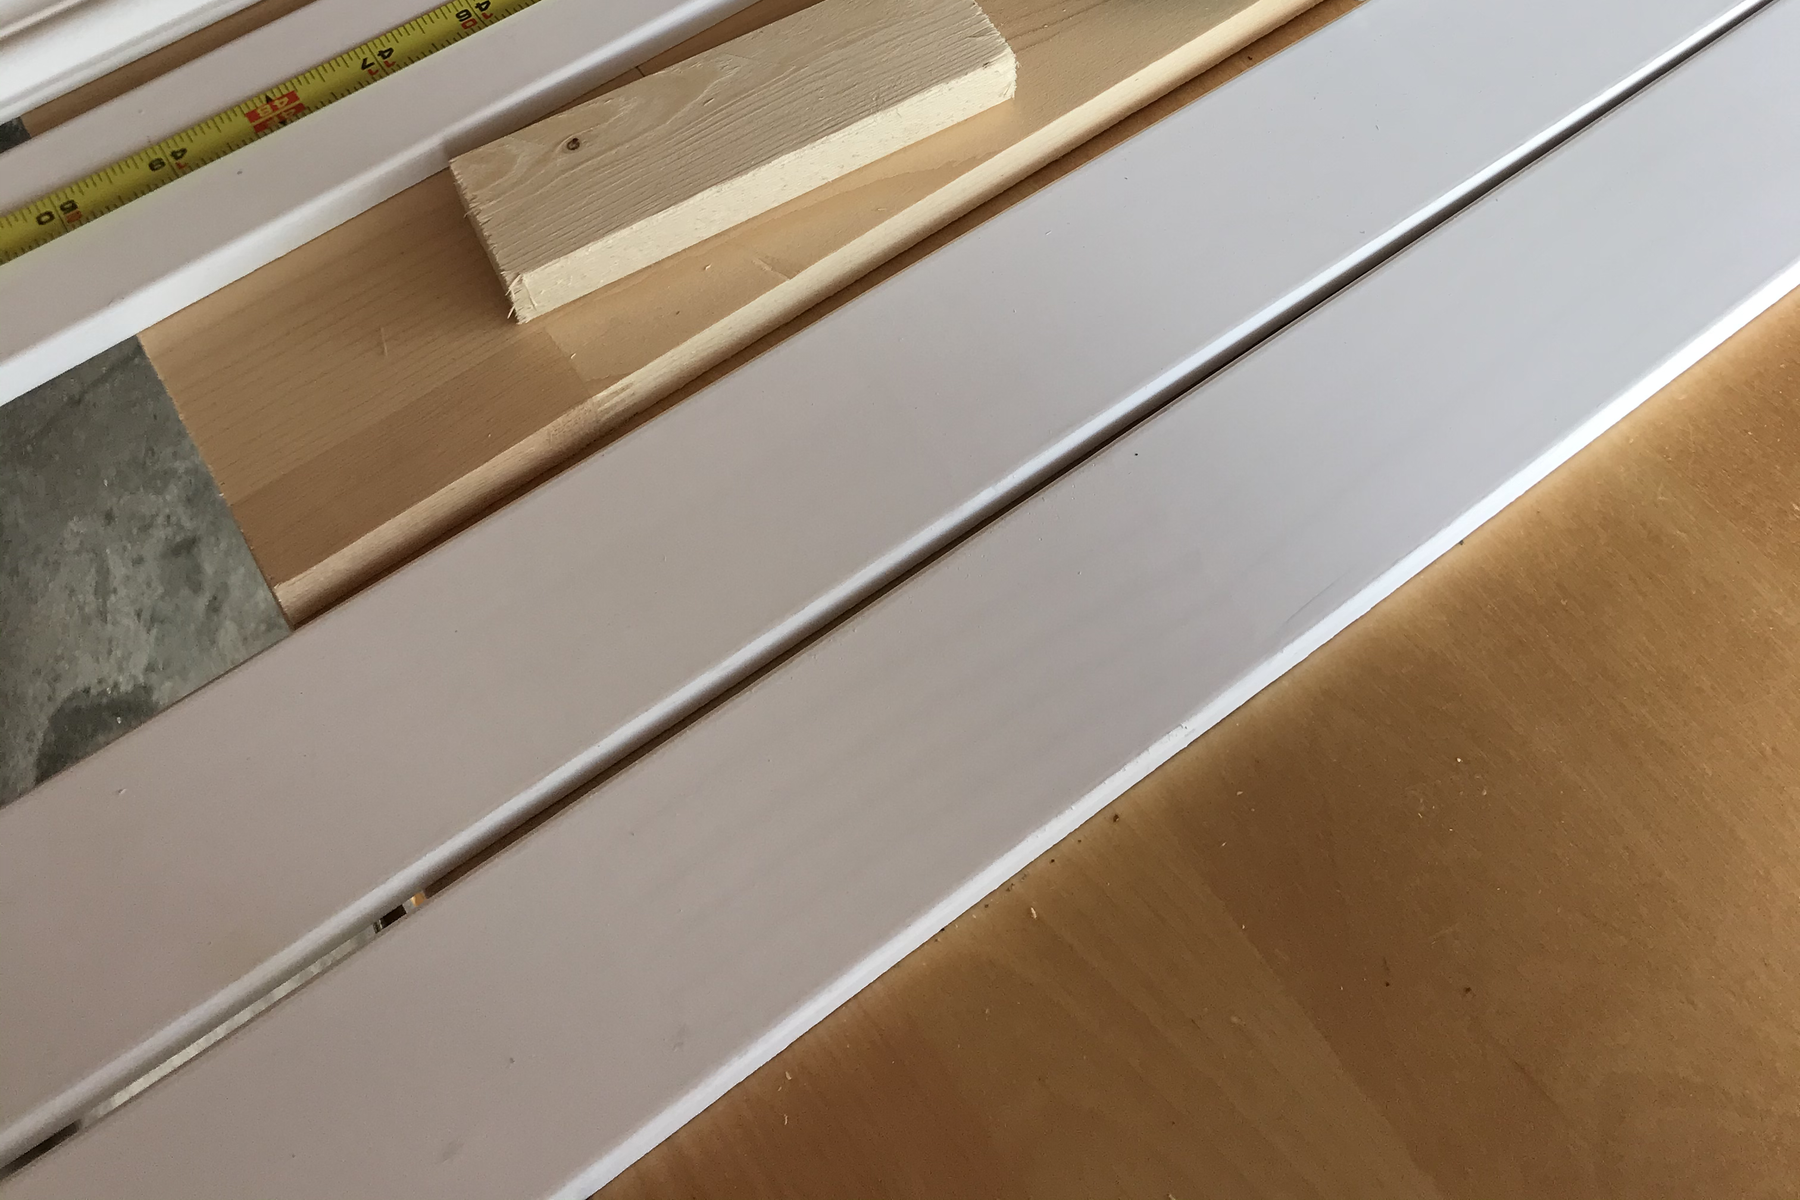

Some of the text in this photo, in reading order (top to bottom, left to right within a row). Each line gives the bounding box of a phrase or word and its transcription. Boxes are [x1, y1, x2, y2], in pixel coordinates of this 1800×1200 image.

[455, 0, 492, 22] 46
[360, 47, 395, 71] 47
[256, 97, 290, 118] 48
[148, 147, 188, 172] 49
[35, 199, 79, 226] 50
